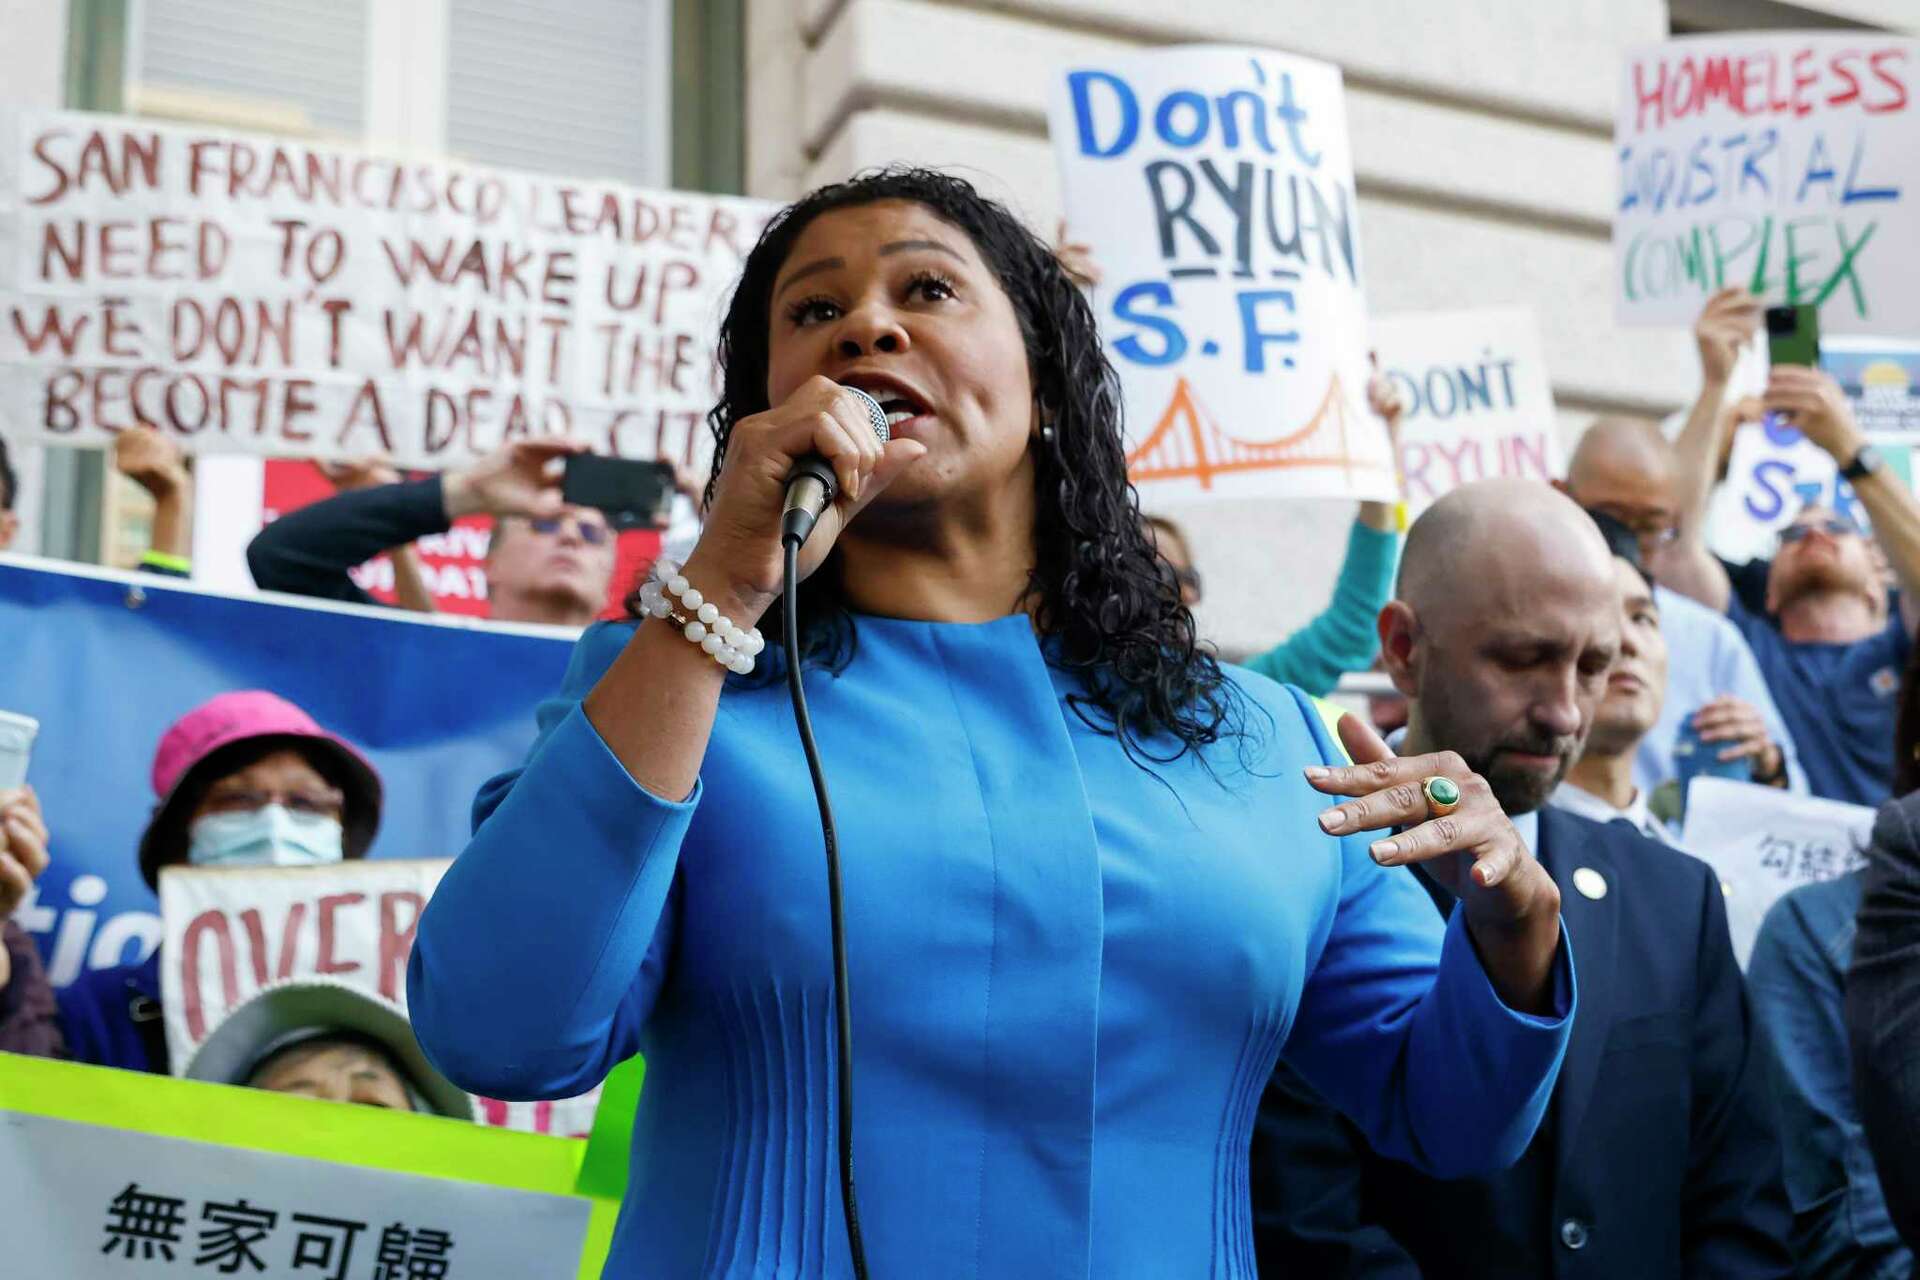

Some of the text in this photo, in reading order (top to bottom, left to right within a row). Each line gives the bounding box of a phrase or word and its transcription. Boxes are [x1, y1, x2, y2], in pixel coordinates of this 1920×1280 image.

[1066, 57, 1321, 168] Don't
[1633, 49, 1908, 133] HOMELESS
[26, 130, 775, 256] SAN FRANCISCO LEADER
[39, 215, 701, 325] NEED TO WAKE UP
[1624, 215, 1878, 320] COMPLEX
[12, 298, 143, 357] WE
[170, 289, 352, 368] DON'T
[383, 305, 570, 385] WANT
[594, 322, 693, 395] THE
[1111, 280, 1301, 374] S.F.
[44, 367, 317, 442] BECOME
[335, 378, 393, 453] A
[424, 387, 572, 455] DEAD
[1385, 344, 1515, 421] DON'T
[100, 1182, 454, 1280] 無家可歸
